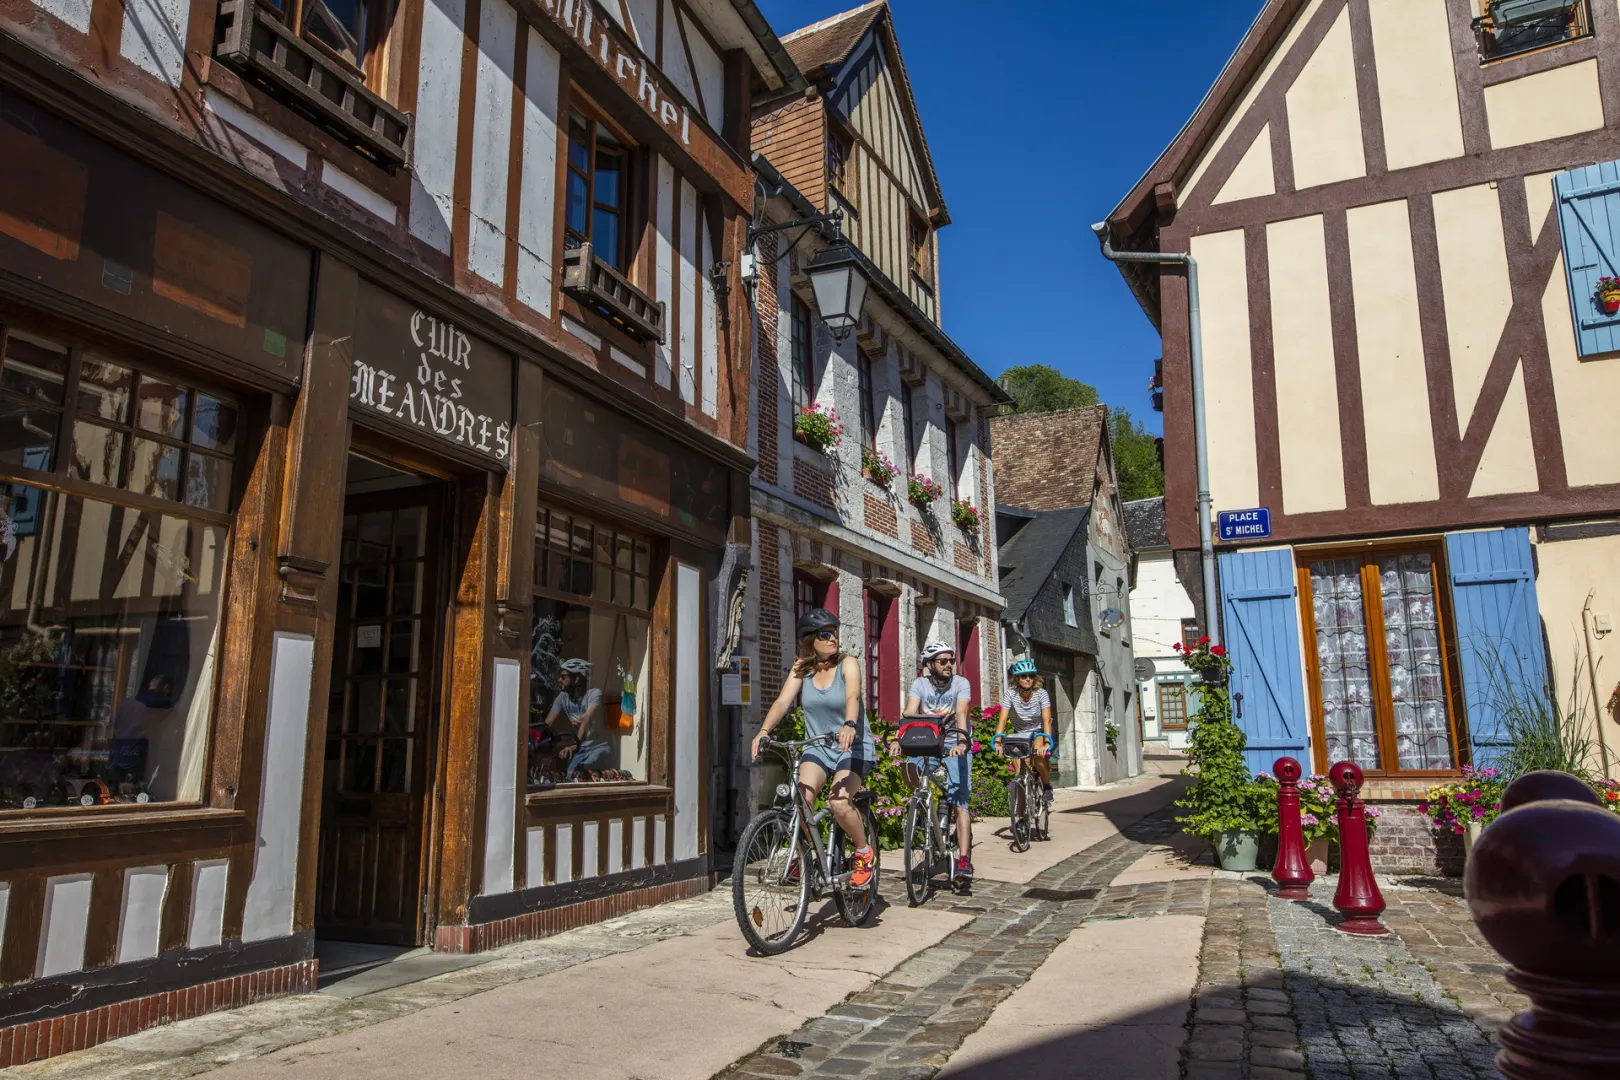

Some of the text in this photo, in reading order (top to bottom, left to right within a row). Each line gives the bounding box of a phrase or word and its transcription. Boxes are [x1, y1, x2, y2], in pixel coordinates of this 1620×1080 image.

[410, 309, 471, 370] CUIR
[417, 352, 463, 399] des
[349, 359, 510, 460] MEANDRES
[1229, 512, 1258, 523] PLACE
[1235, 524, 1264, 535] MICHEL
